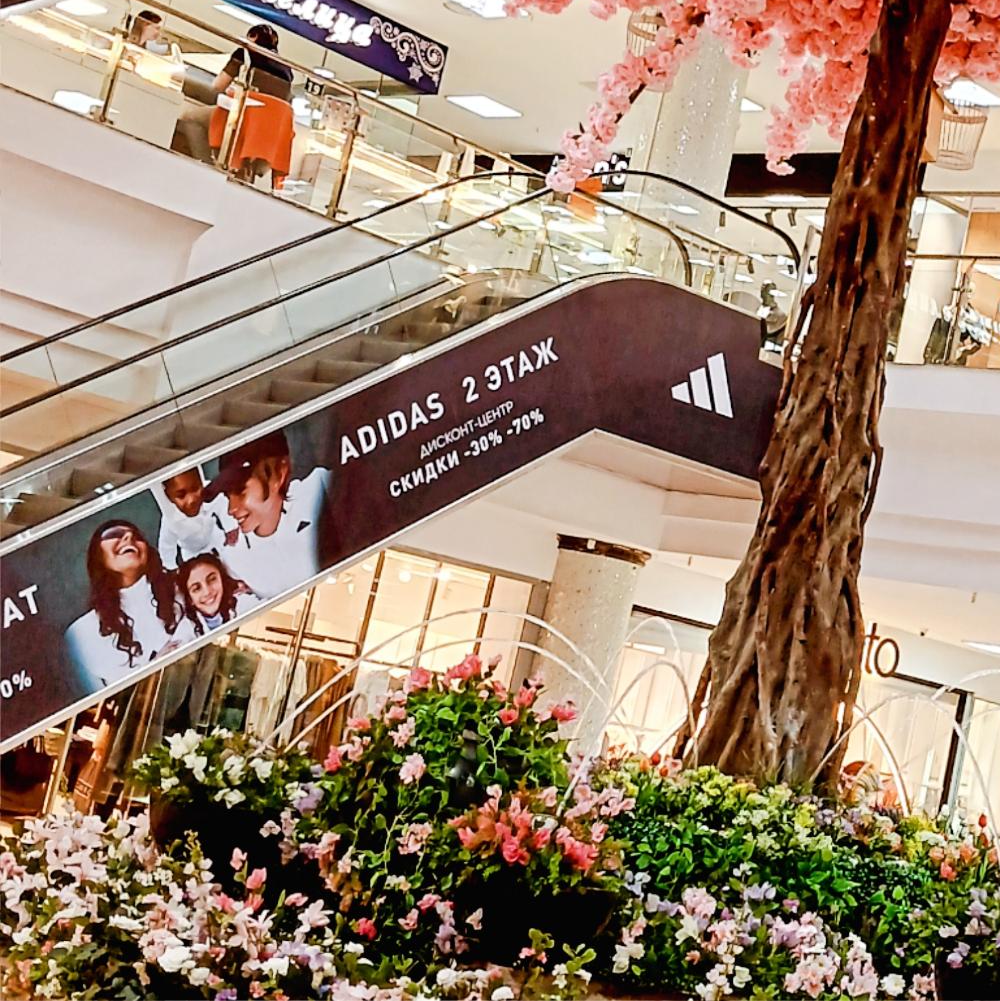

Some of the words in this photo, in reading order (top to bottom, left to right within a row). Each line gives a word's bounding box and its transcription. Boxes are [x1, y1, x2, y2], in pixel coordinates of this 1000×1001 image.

[341, 392, 445, 464] ADIDAS
[461, 376, 480, 404] 2
[484, 337, 559, 391] ЭТАЖ
[420, 400, 514, 460] ДИСКОНТ-ЦЕНТР
[389, 450, 460, 498] СКИДКИ
[463, 431, 503, 457] -30%
[506, 408, 545, 436] -70%
